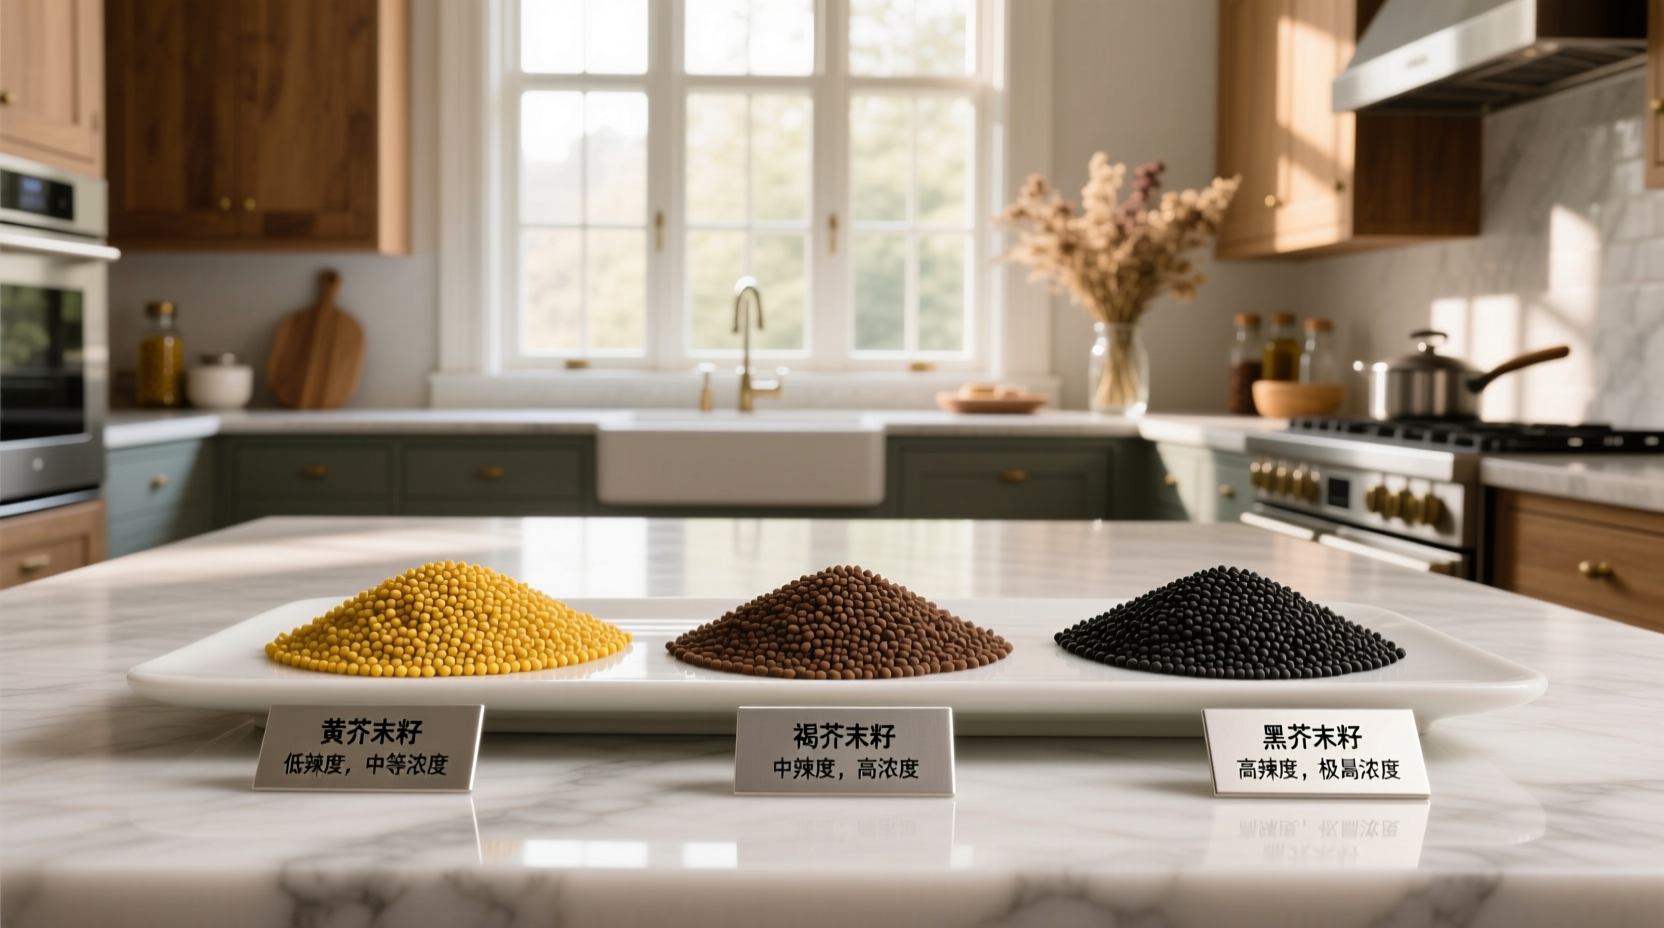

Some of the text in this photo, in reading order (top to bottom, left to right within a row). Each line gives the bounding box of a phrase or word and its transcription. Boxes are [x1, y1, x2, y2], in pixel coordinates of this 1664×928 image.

[321, 717, 423, 745] 黄芥末籽
[793, 722, 896, 750] 褐芥末籽
[1262, 723, 1363, 750] 黑芥末籽
